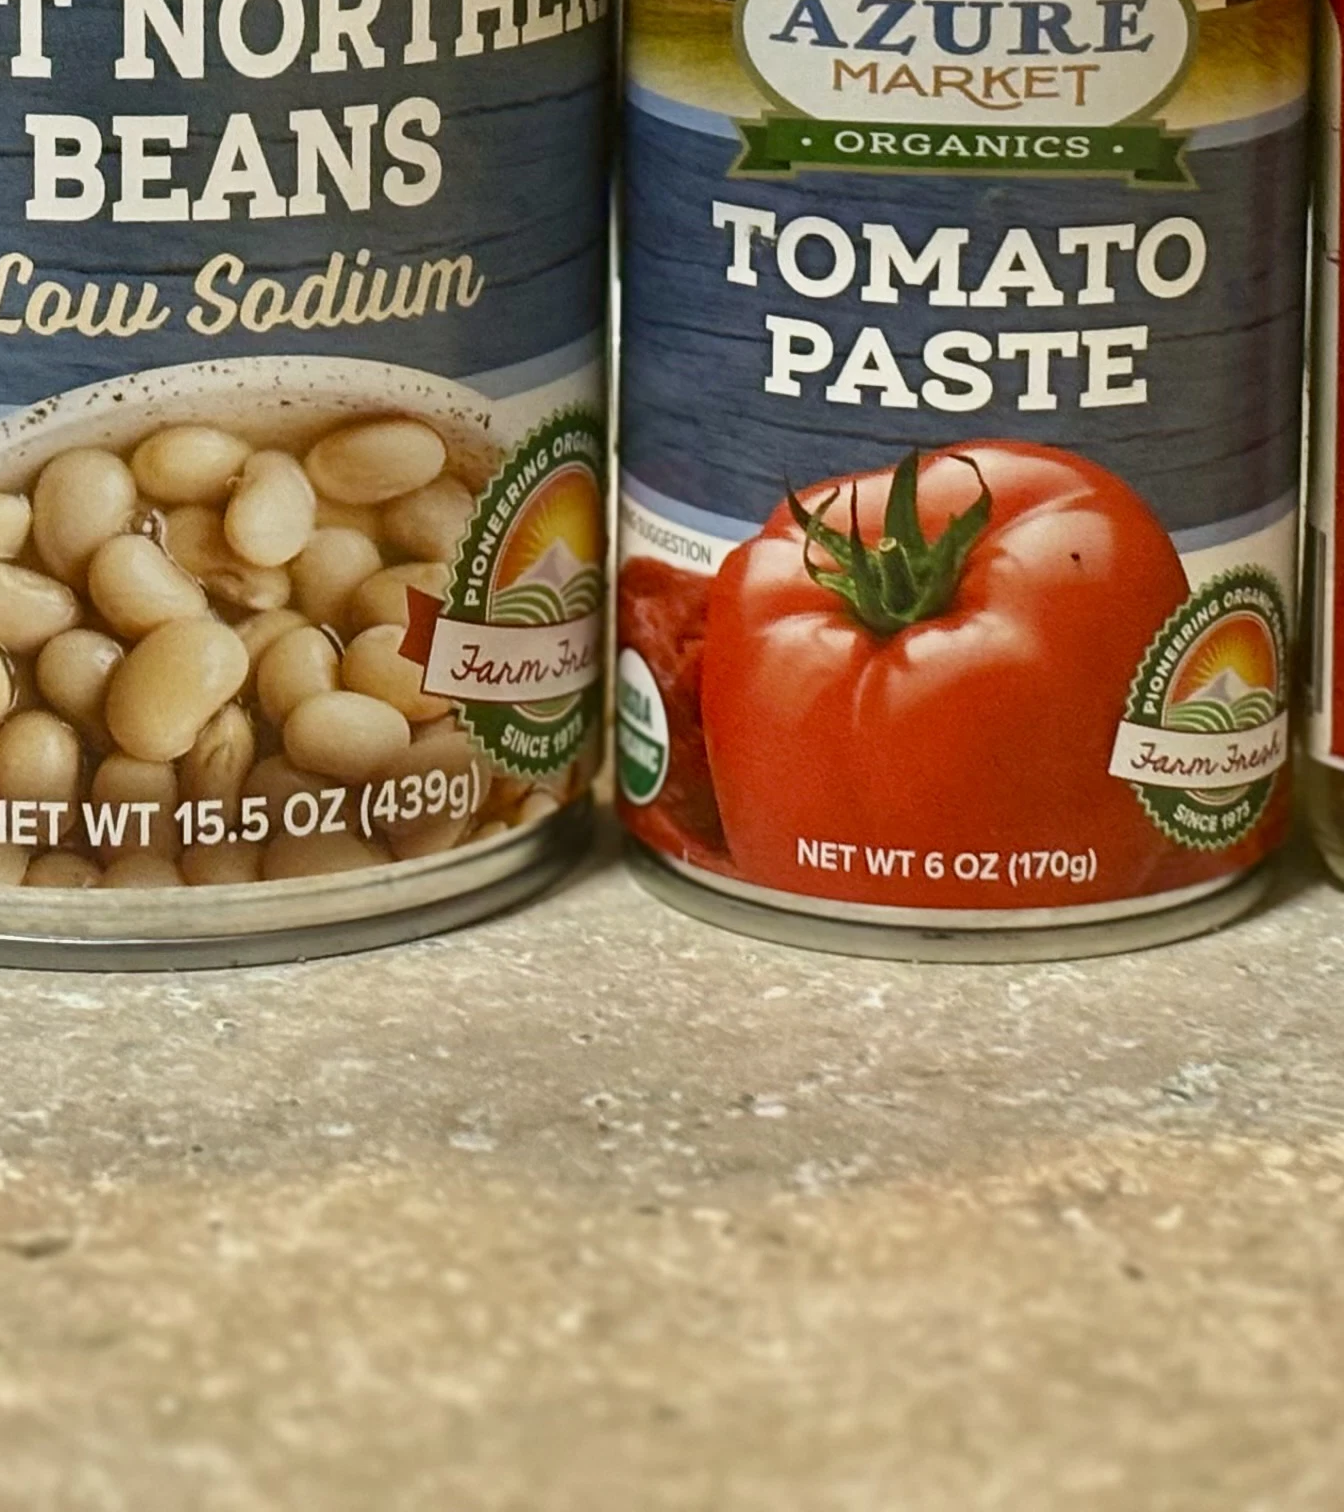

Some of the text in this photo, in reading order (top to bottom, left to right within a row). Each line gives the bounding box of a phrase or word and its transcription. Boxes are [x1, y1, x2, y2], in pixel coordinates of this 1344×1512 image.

[831, 58, 1100, 110] MARKET
[24, 96, 442, 223] BEANS
[833, 129, 1091, 159] ORGANICS
[711, 200, 1208, 307] TOMATO
[186, 249, 485, 336] Sodium
[764, 313, 1148, 412] PASTE
[464, 450, 549, 607] PIONEERING
[451, 643, 549, 685] Farm
[1142, 598, 1221, 715] PIONEERING
[500, 723, 551, 759] SINCE
[1129, 731, 1283, 777] Farm Fresh
[82, 801, 160, 847] WT
[173, 796, 270, 845] 15.5
[283, 787, 347, 837] OZ
[359, 760, 481, 839] (439g)
[1172, 803, 1219, 833] SINCE
[797, 836, 1098, 888] NET WT 6 OZ (170g)
